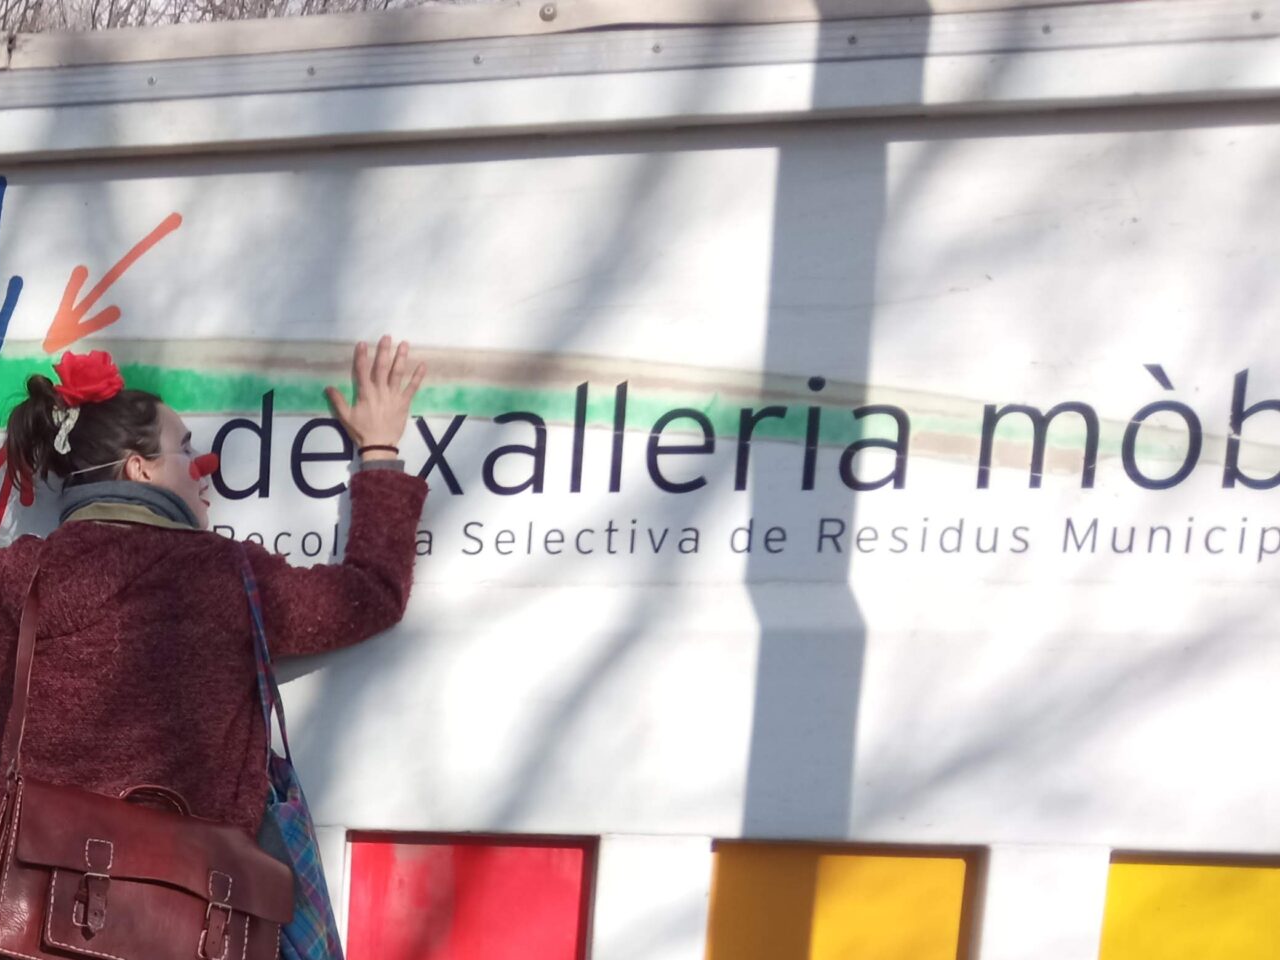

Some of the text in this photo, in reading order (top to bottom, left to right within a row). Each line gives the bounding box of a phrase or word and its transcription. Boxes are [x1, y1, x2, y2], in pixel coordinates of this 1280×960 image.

[211, 376, 911, 500] dexalleria
[461, 519, 701, 556] Selectiva
[730, 518, 788, 555] de
[816, 517, 1031, 555] Residus
